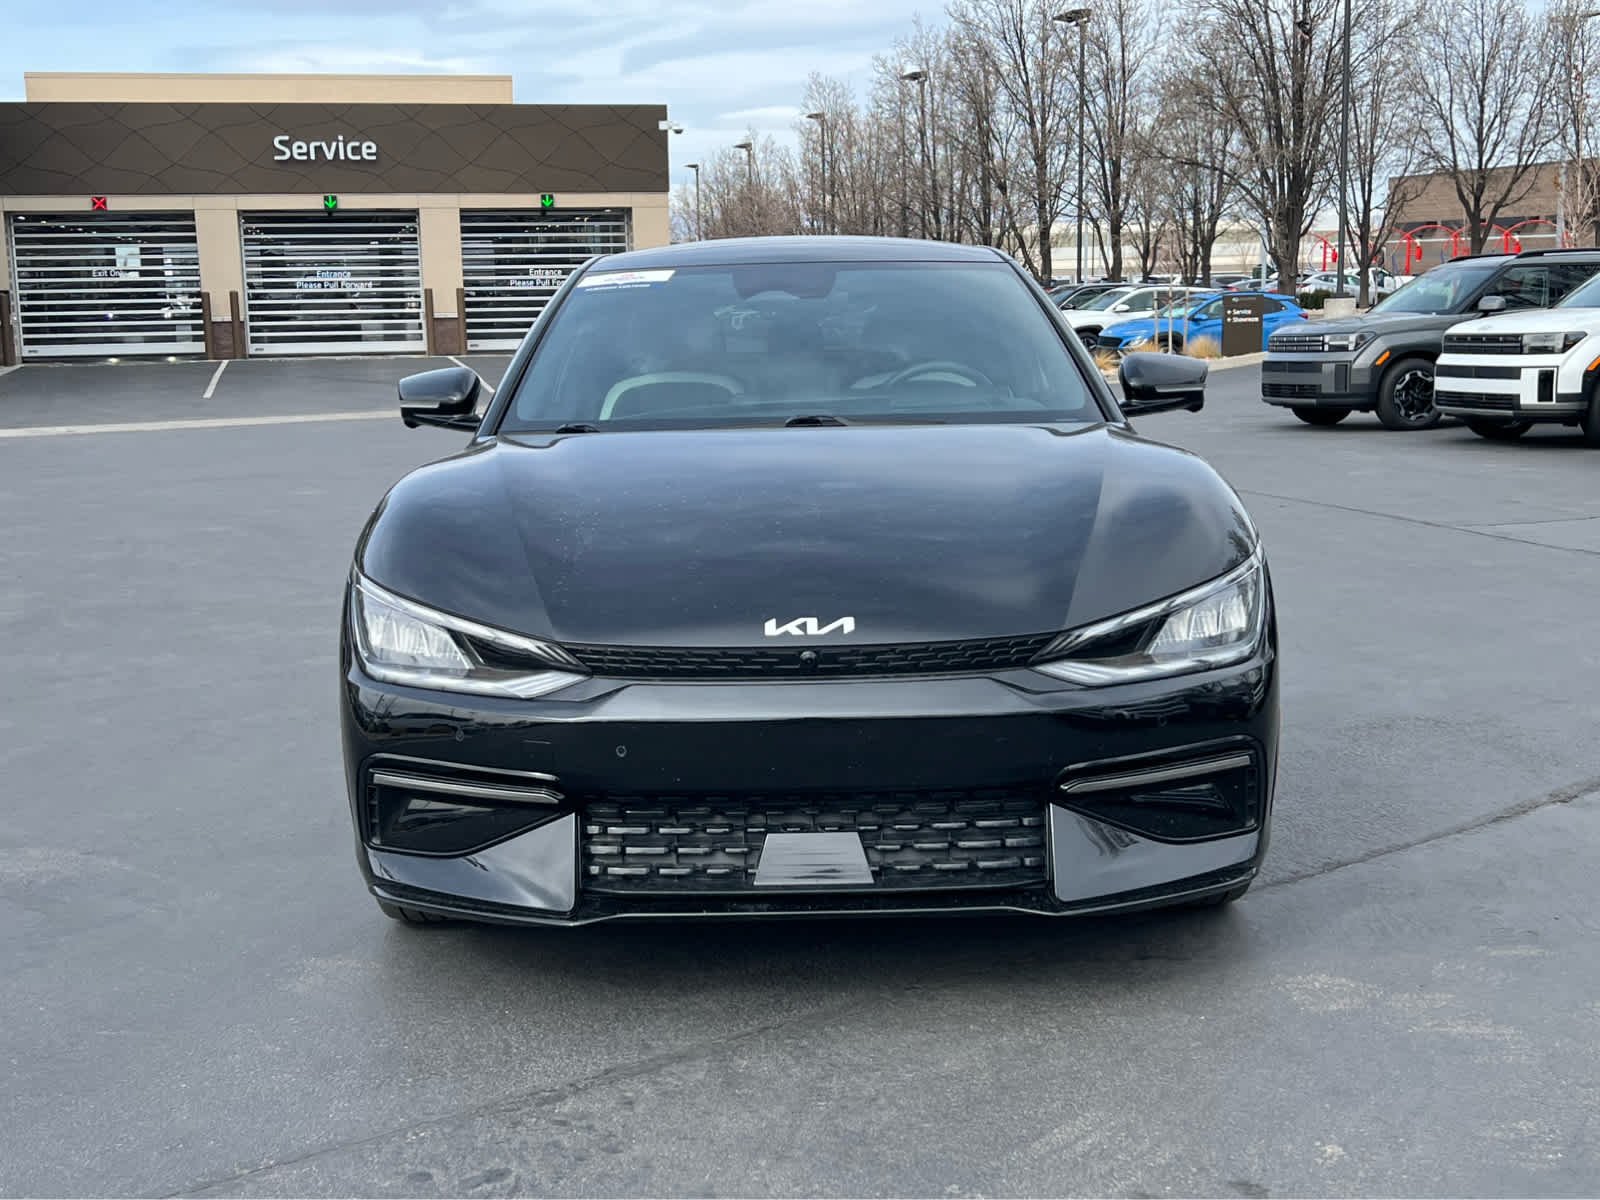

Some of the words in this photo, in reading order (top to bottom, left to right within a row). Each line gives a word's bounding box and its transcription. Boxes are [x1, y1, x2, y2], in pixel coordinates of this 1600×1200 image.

[273, 135, 377, 161] Service
[92, 269, 108, 277] Exit
[316, 270, 351, 279] Entrance
[529, 268, 562, 276] Entrance
[509, 279, 534, 287] Please
[535, 279, 550, 287] Pull
[764, 616, 855, 636] KIA
